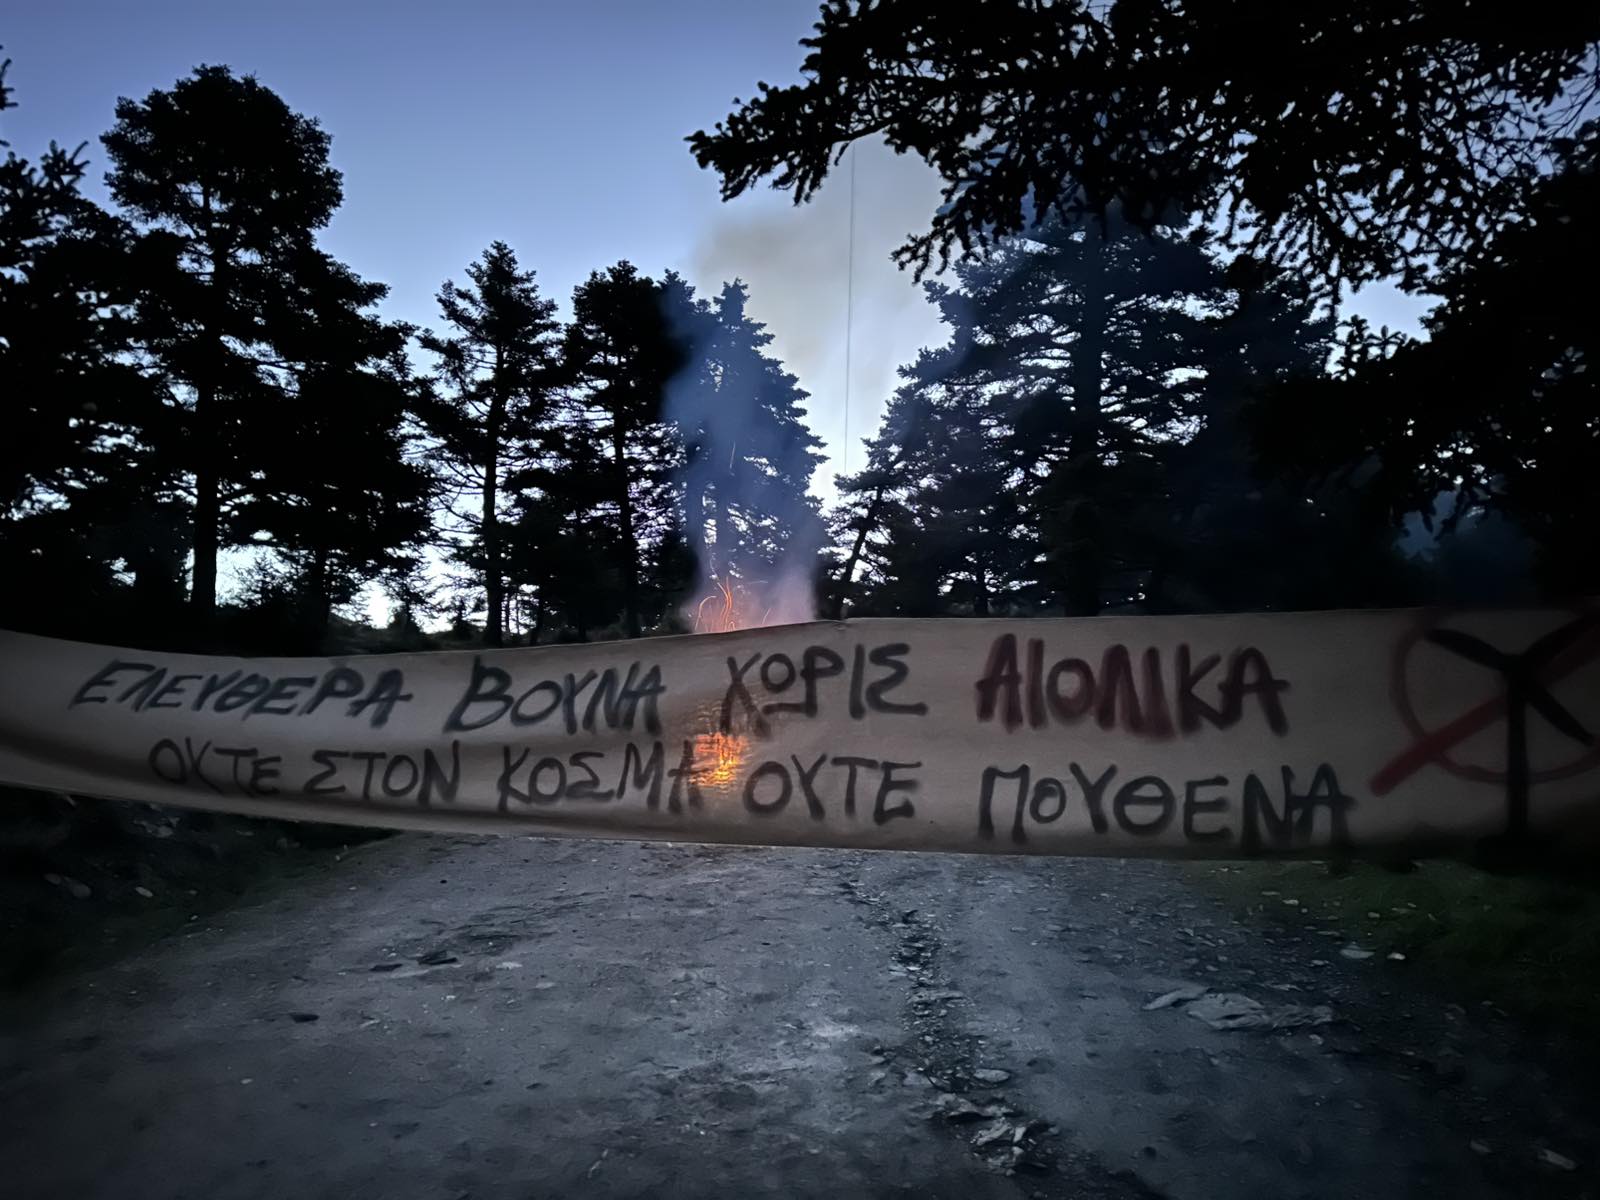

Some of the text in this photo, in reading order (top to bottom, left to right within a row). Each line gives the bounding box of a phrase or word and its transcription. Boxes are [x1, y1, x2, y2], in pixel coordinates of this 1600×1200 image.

[69, 633, 1291, 740] ΕΛΕΥΘΕΡΑ ΒΟΥΝΑ ΧΩΡΙΣ ΑΙΟΛΙΚΑ
[148, 736, 281, 799] ΟΥΤΕ
[303, 740, 461, 807] ΣΤΟΝ
[743, 753, 922, 825] ΟΥΤΕ
[978, 762, 1355, 850] ΠΟΥΘΕΝΑ
